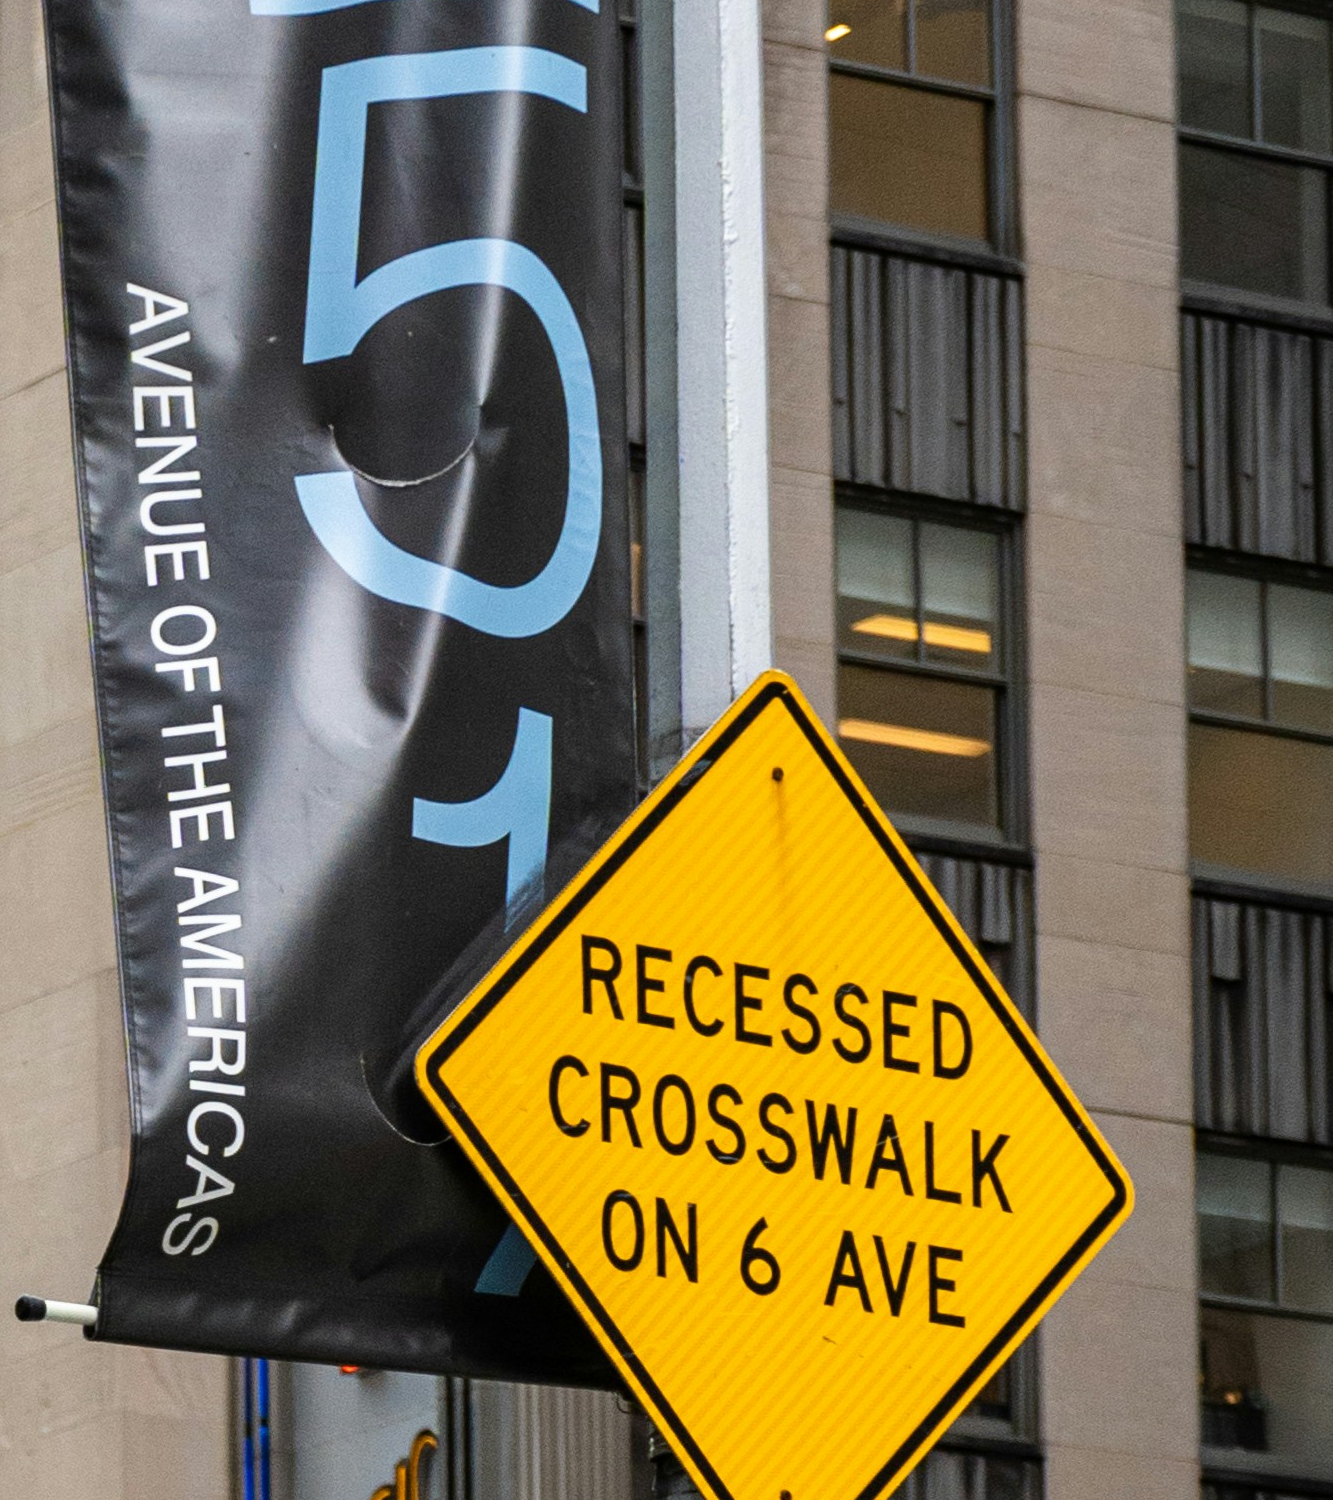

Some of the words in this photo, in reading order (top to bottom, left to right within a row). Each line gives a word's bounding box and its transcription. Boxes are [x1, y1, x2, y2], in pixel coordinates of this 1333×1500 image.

[125, 282, 210, 587] AVENUE
[150, 603, 221, 694] OF
[161, 700, 236, 849] THE
[161, 866, 247, 1258] AMERICAS
[579, 933, 972, 1080] RECESSED
[547, 1054, 1013, 1214] CROSSWALK
[601, 1189, 699, 1284] ON
[740, 1216, 781, 1296] 6
[823, 1229, 967, 1329] AVE
